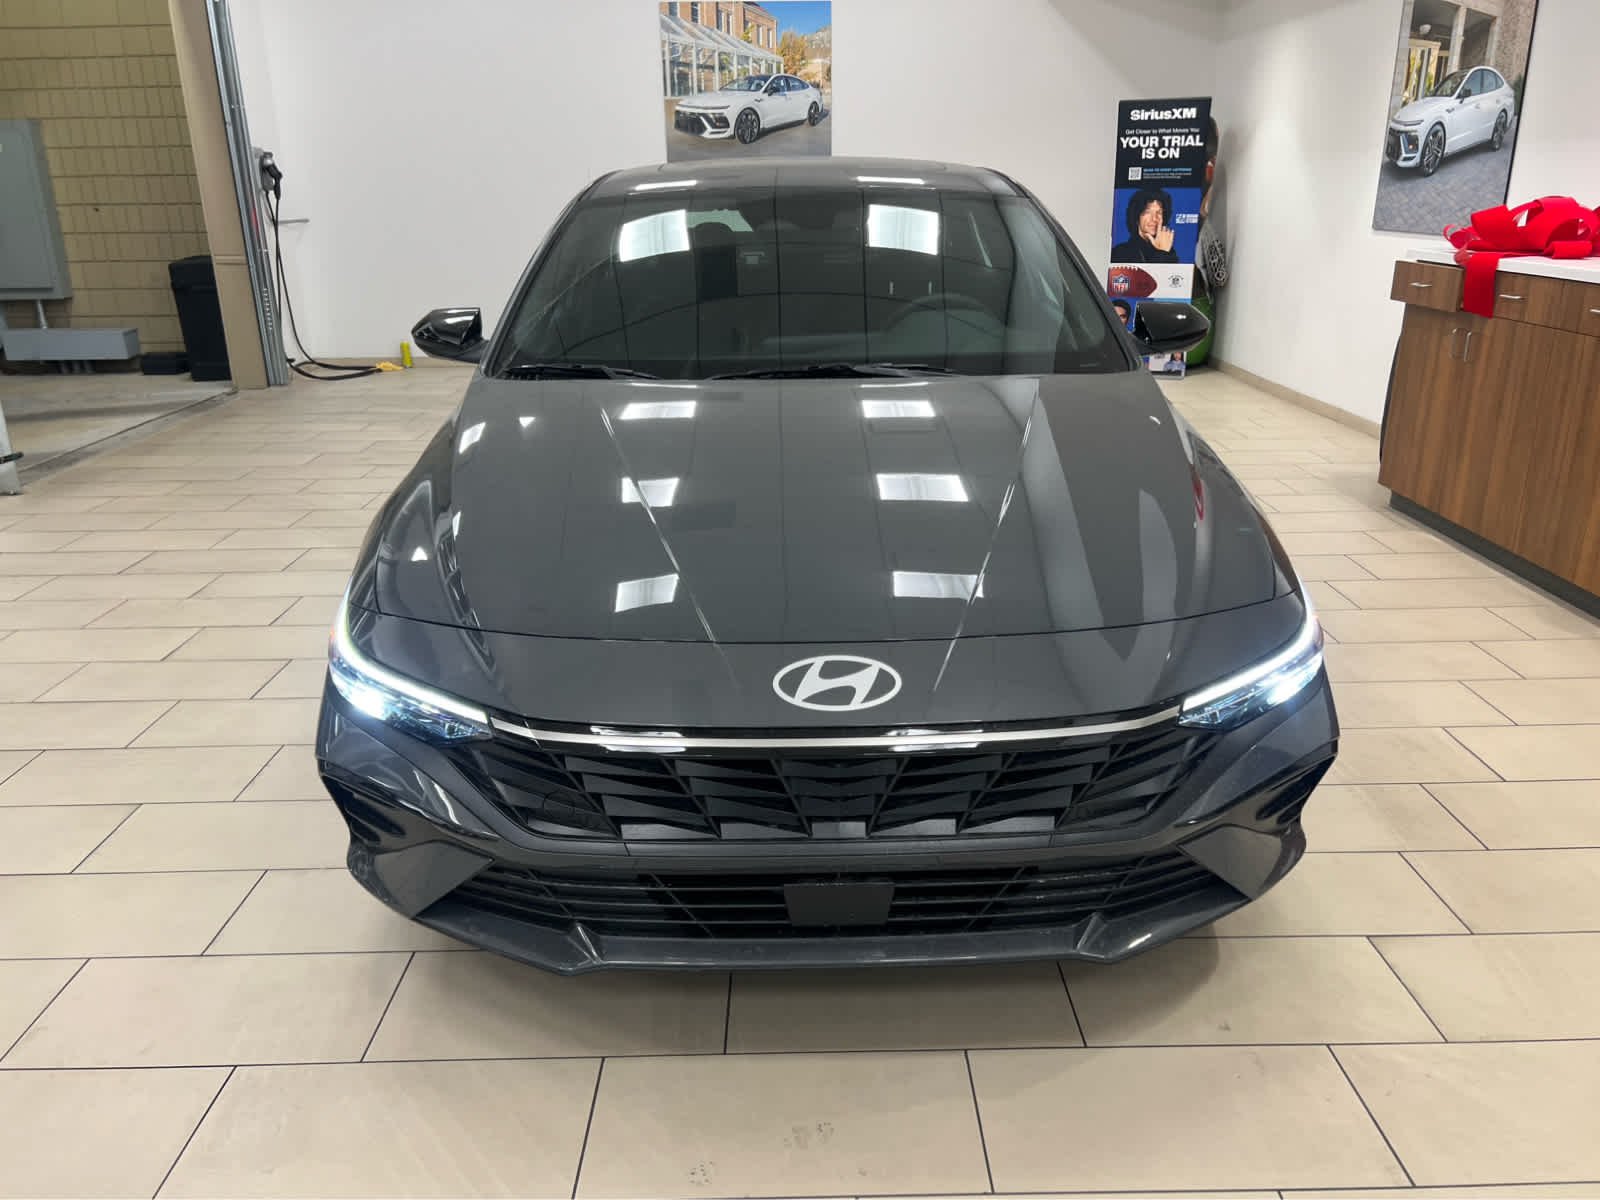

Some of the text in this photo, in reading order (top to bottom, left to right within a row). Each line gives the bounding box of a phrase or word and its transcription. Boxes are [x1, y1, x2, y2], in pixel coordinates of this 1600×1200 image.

[1130, 107, 1197, 121] SiriusXM
[1120, 134, 1204, 148] YOUR TRIAL
[1142, 147, 1180, 159] IS ON
